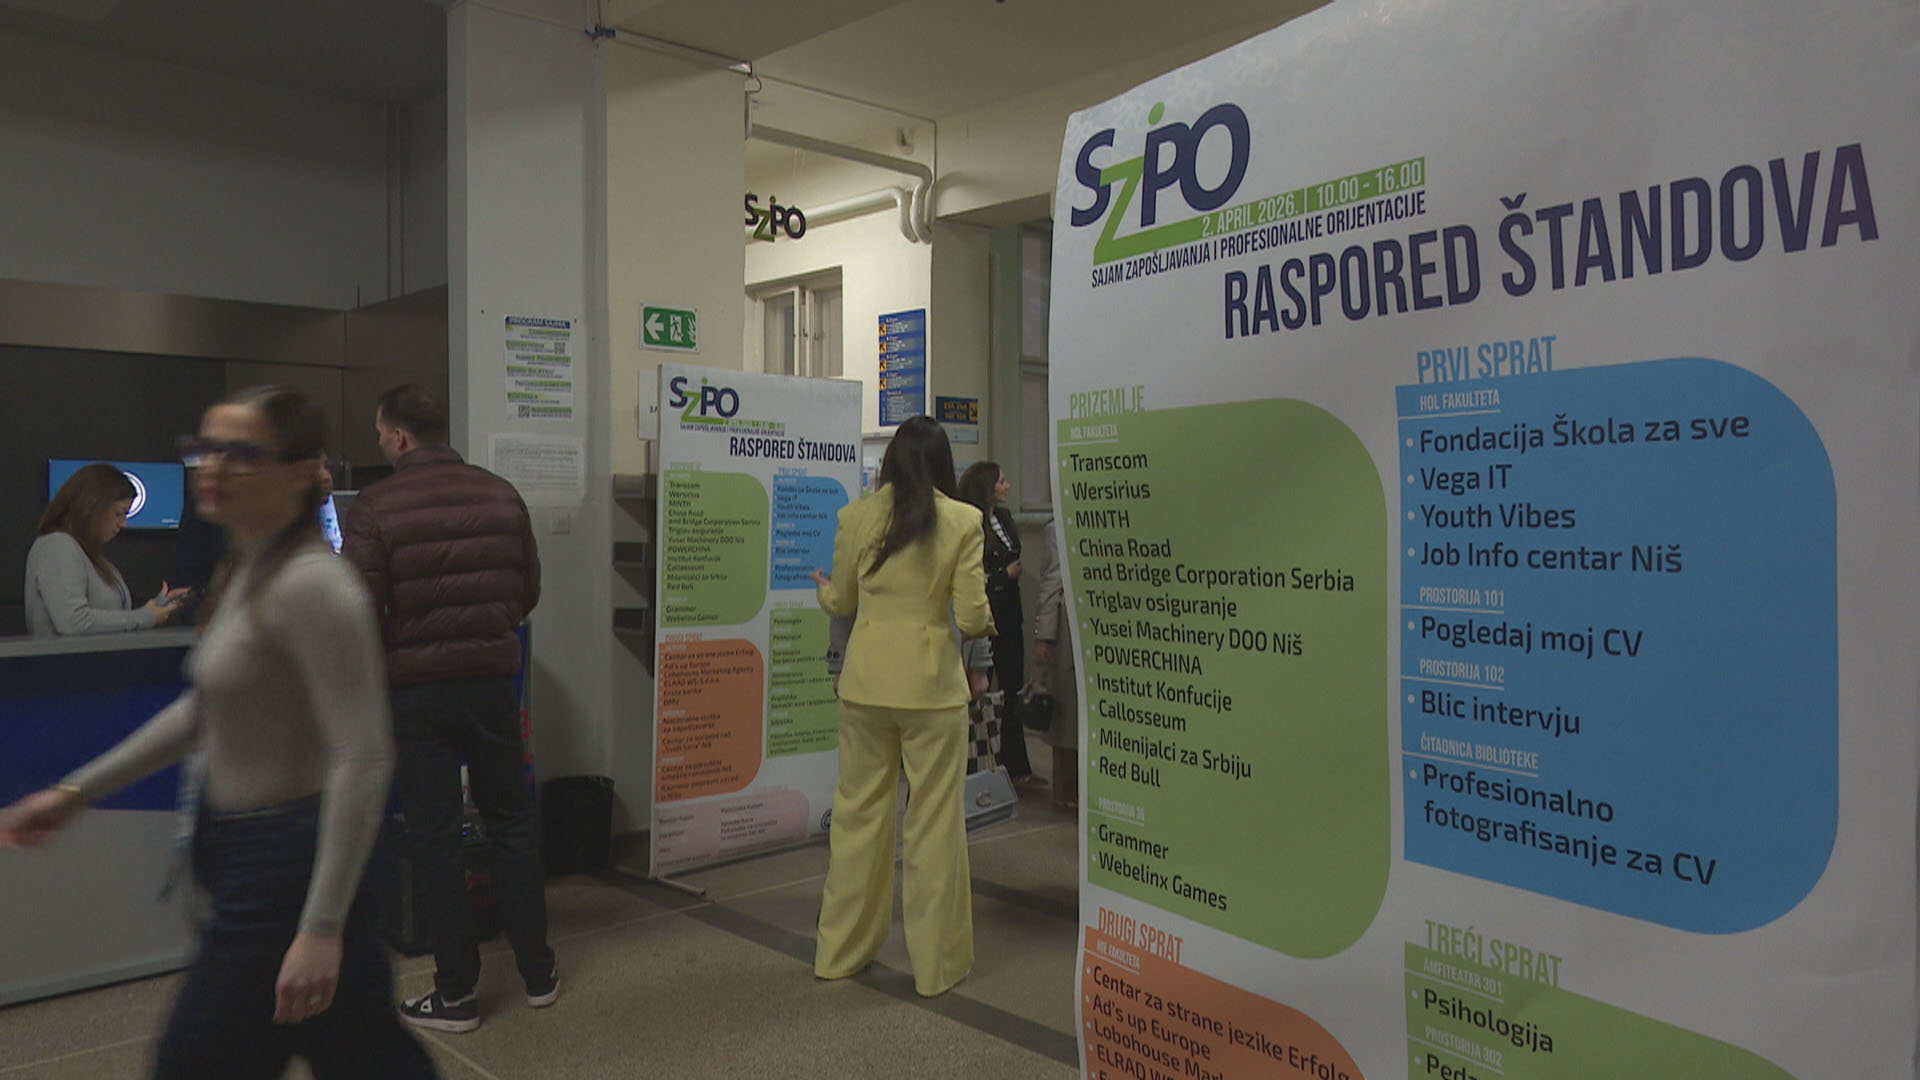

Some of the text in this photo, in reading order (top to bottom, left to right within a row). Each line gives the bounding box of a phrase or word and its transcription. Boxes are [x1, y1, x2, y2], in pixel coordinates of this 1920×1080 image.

[1202, 216, 1214, 238] 2.
[1217, 203, 1255, 234] APRIL
[1258, 193, 1299, 222] 2026.
[1317, 179, 1360, 209] 10.00
[1376, 161, 1422, 194] 16.00
[1092, 191, 1426, 288] SAJAM ZAPOŠLJAVANJA I PROFESIONALNE ORIJENTACIJE
[1225, 143, 1880, 340] RASPORED ŠTANDOVA
[1416, 335, 1556, 386] PRVI SPRAT
[1420, 389, 1500, 411] HOL FAKULTETA
[730, 436, 856, 463] RASPORED ŠTANDOVA
[1419, 413, 1750, 454] Fondacija Škola za sve
[1070, 453, 1148, 473] Transcom
[1420, 464, 1512, 495] Vega IT
[1072, 480, 1150, 501] Wersirius
[1076, 510, 1130, 529] MINTH
[1420, 504, 1576, 529] Youth Vibes
[1080, 538, 1171, 558] China Road
[1420, 542, 1683, 573] Job Info centar Niš
[1083, 563, 1354, 592] and Bridge Corporation Serbia
[1086, 590, 1237, 621] Triglav osiguranje
[1420, 587, 1504, 607] PROSTORIJA 101
[1090, 617, 1303, 656] Yusei Machinery DOO Niš
[1421, 616, 1643, 659] Pogledaj moj CV
[1094, 645, 1202, 676] POWERCHINA
[1420, 659, 1504, 683] PROSTORIJA 102
[1097, 672, 1232, 714] Institut Konfucije
[1099, 699, 1186, 732] Callosseum
[1421, 690, 1580, 738] Blic intervju
[1100, 728, 1251, 781] Milenijalci za Srbiju
[1100, 756, 1160, 788] Red Bull
[1475, 742, 1539, 770] BIBLIOTEKE
[1423, 763, 1614, 822] Profesionalno
[1099, 824, 1169, 860] Grammer
[1424, 801, 1716, 885] fotografisanje za CV
[1099, 851, 1228, 911] Webelinx Games
[1099, 906, 1183, 965] DRUGI SPRAT
[1424, 920, 1562, 987] TREĆI SPRAT
[1423, 958, 1481, 989] AMFITEATAR
[1093, 994, 1211, 1060] Ad's up Europe
[1094, 966, 1141, 1002] Centar
[1144, 991, 1163, 1012] za
[1167, 1002, 1223, 1037] strane
[1229, 1021, 1283, 1062] jezike
[1424, 988, 1553, 1053] Psihologija
[1095, 1018, 1180, 1072] Lobohouse
[1097, 1044, 1146, 1080] ELRAD
